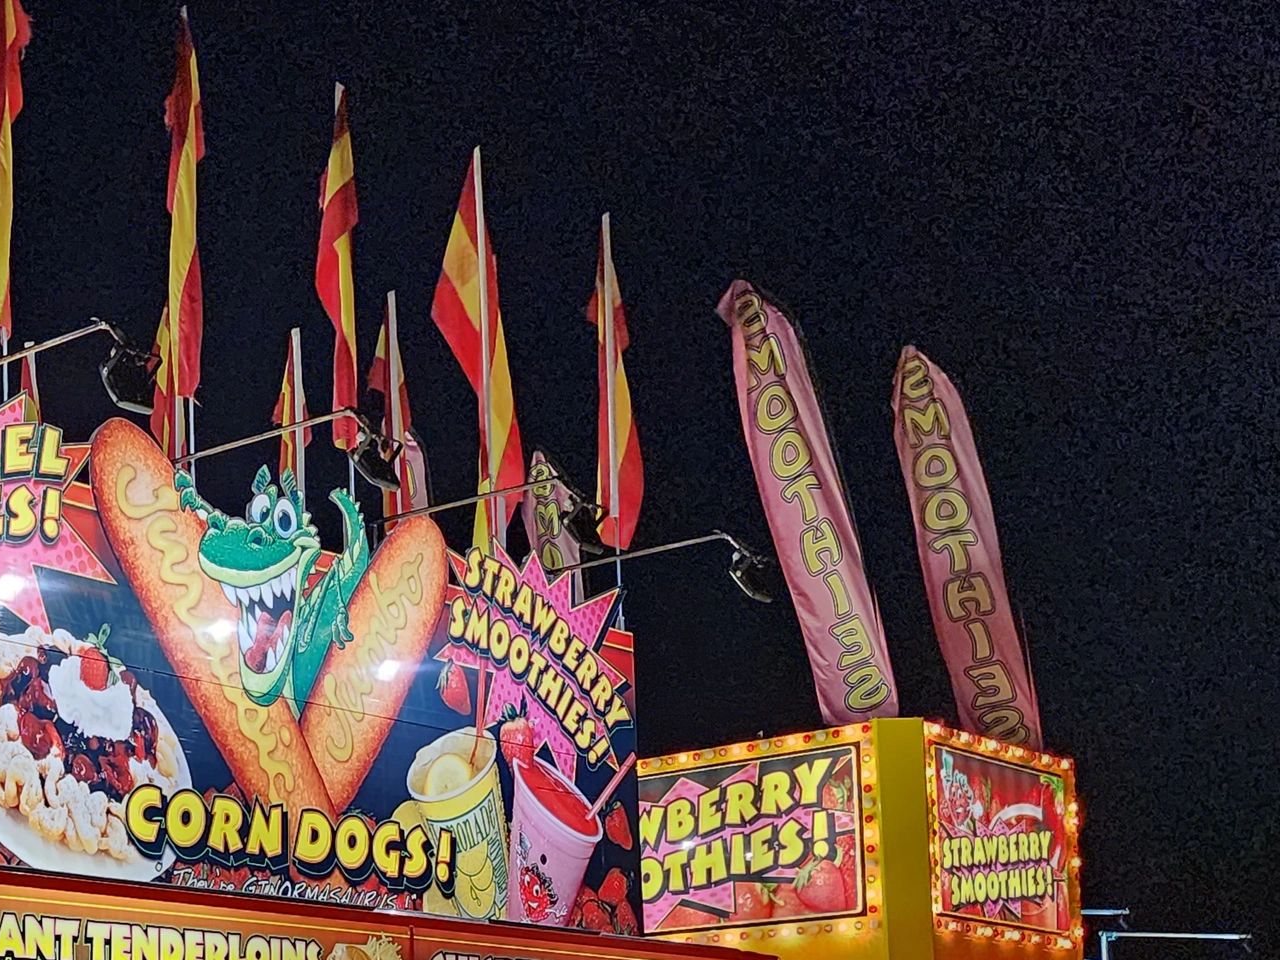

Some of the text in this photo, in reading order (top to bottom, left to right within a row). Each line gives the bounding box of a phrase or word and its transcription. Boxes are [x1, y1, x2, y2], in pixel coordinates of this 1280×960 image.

[449, 596, 608, 768] SMOOTHIES!
[466, 547, 634, 729] STRAWBERRY
[125, 786, 286, 860] CORN
[295, 809, 456, 884] DOGS!
[943, 831, 1052, 869] STRAWBERRY
[952, 865, 1053, 906] SMOOTHIES!
